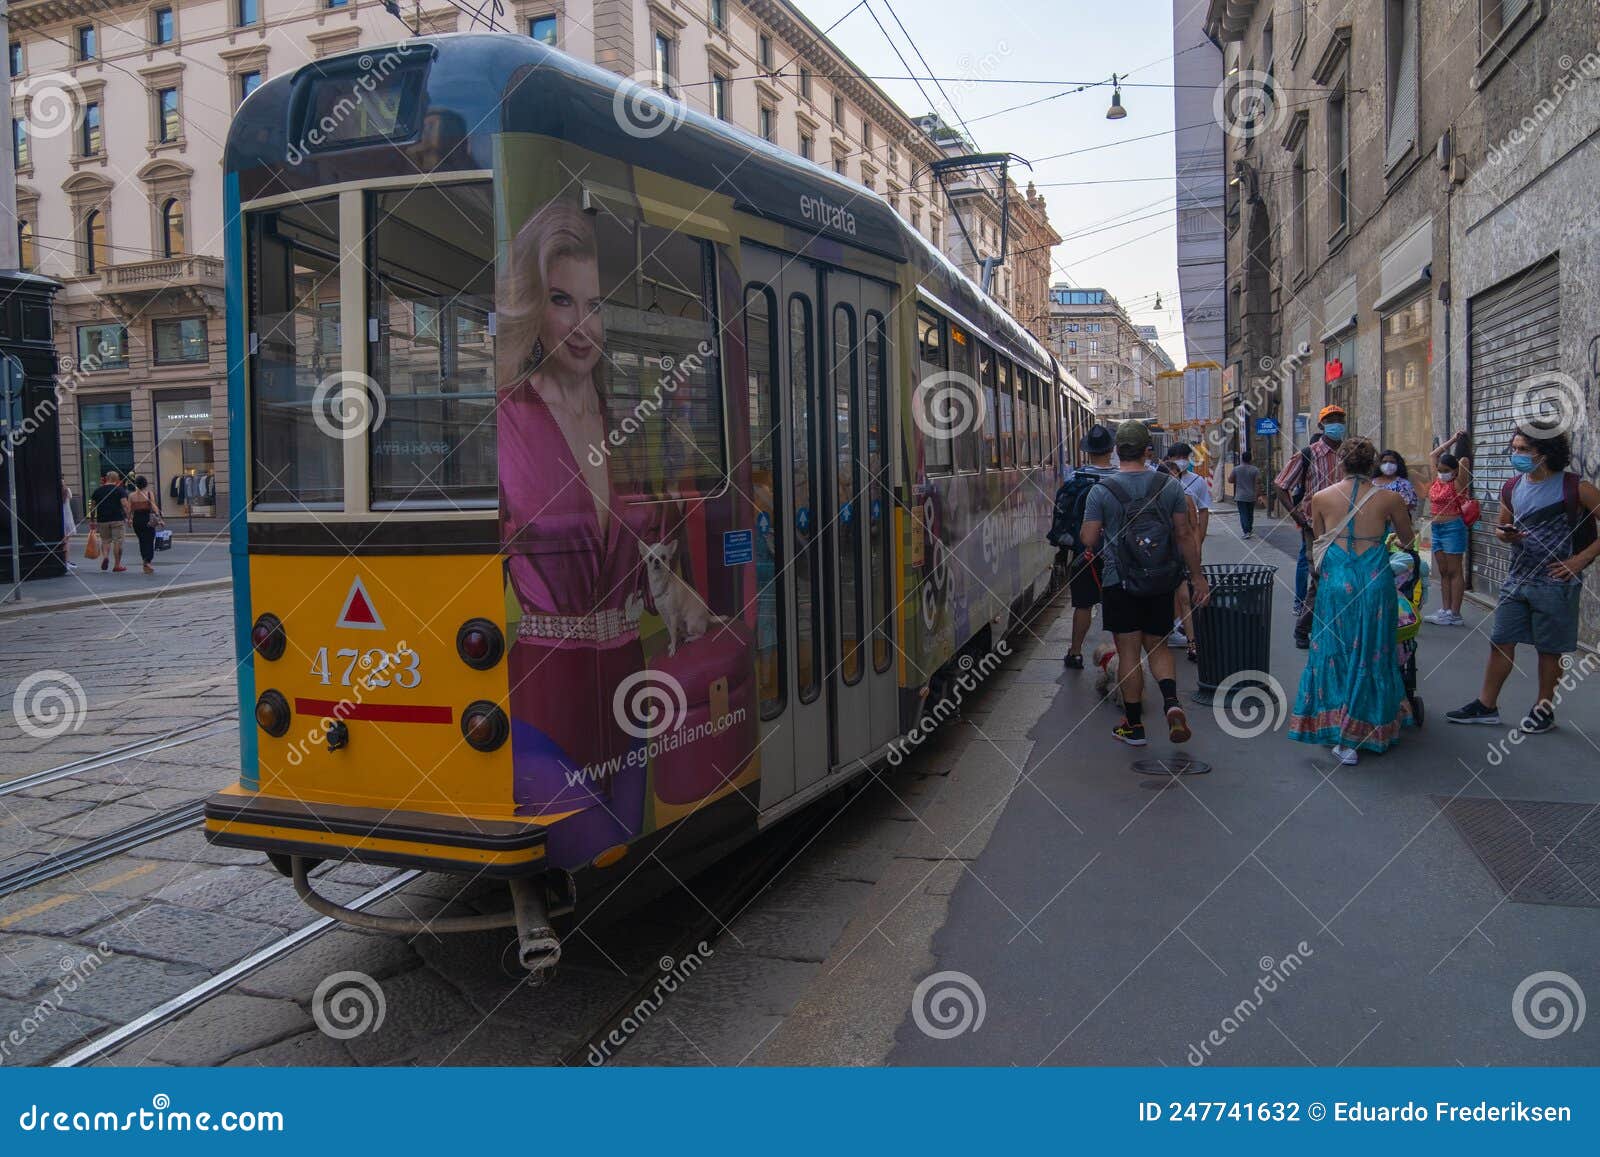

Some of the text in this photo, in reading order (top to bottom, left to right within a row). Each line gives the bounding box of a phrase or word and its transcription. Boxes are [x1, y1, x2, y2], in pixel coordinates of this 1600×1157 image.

[800, 194, 857, 236] entrata
[309, 646, 422, 689] 4723
[564, 707, 747, 788] www.egoitaliano.com
